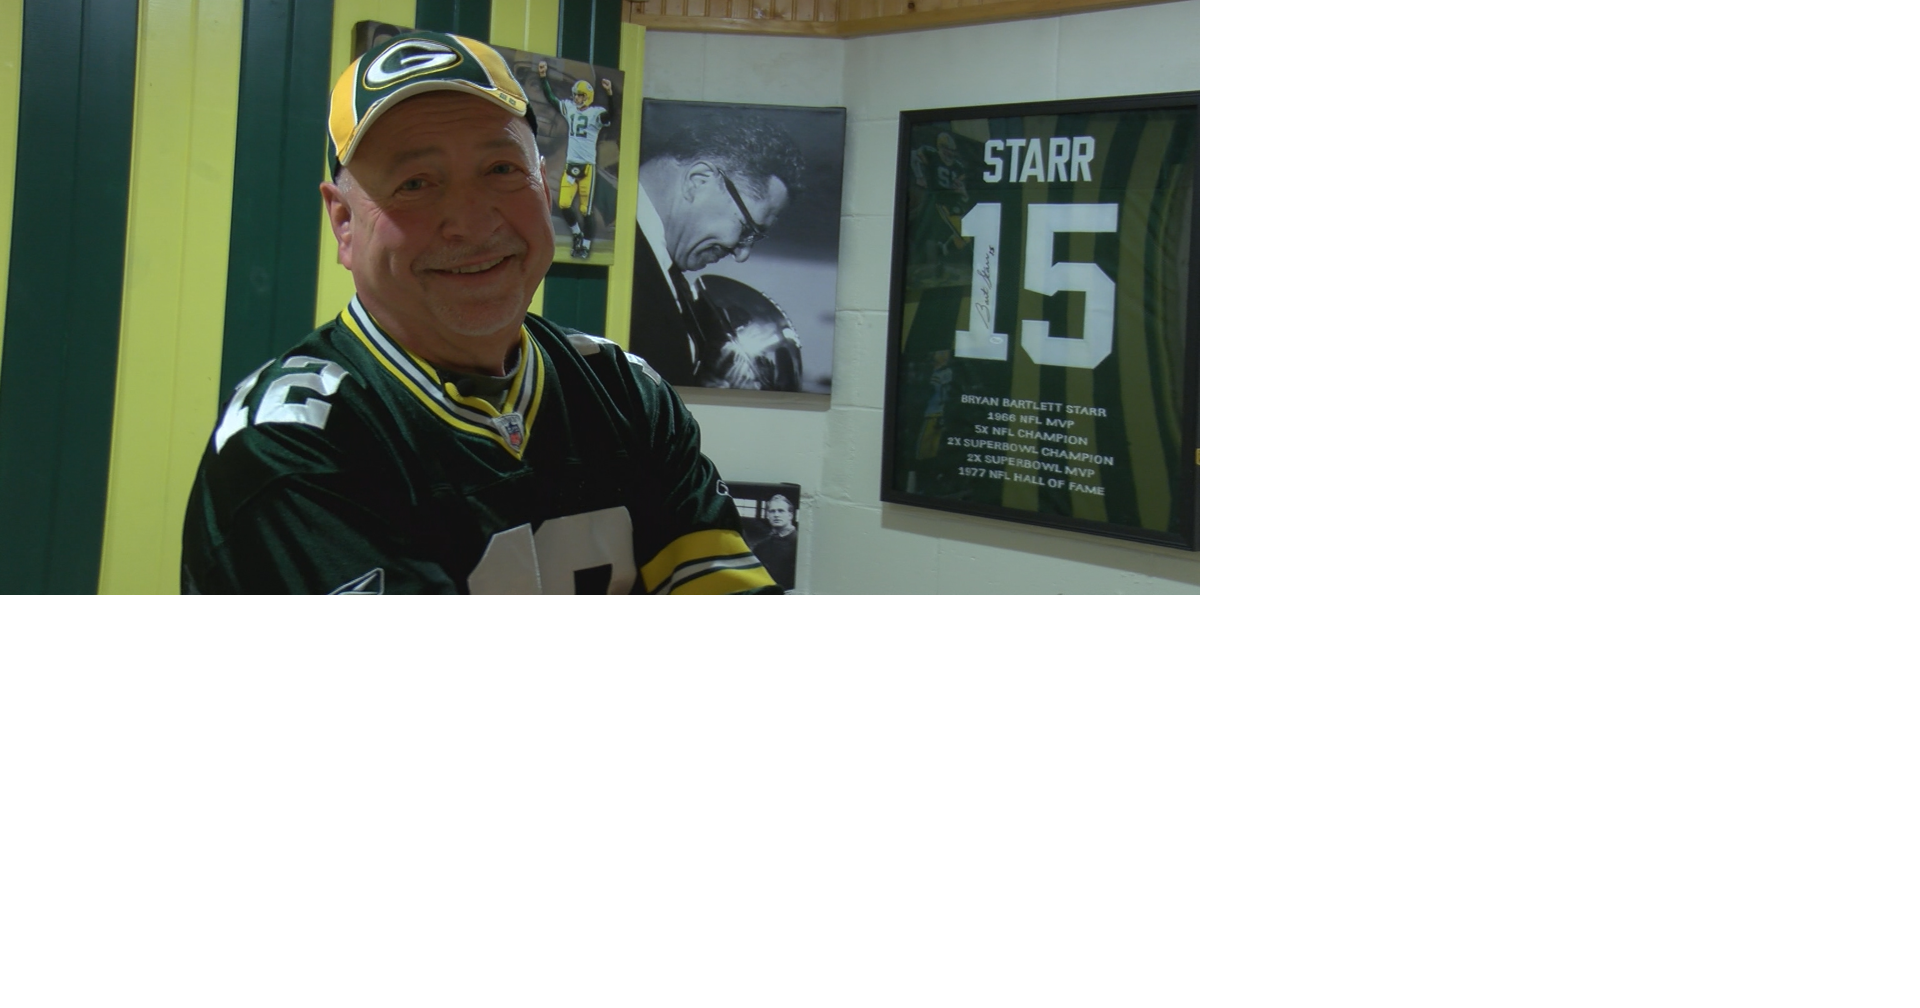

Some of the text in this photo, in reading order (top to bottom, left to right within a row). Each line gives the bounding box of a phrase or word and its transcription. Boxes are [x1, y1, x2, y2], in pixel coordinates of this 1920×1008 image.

[362, 38, 464, 91] G
[570, 113, 588, 138] 12
[983, 136, 1095, 183] STARR
[954, 202, 1119, 369] 15
[213, 355, 352, 455] 12
[961, 394, 1107, 417] BRYAN BARTLETT STARR
[987, 412, 1075, 429] 1966 NFL MVP
[974, 425, 1088, 446] 5X NFL CHAMPION
[947, 437, 1114, 466] 2X SUPERBOWL CHAMPION
[967, 453, 1095, 478] 2X SUPERBOWL MVP
[958, 467, 1105, 496] 1977 NFL HALL OF FAME
